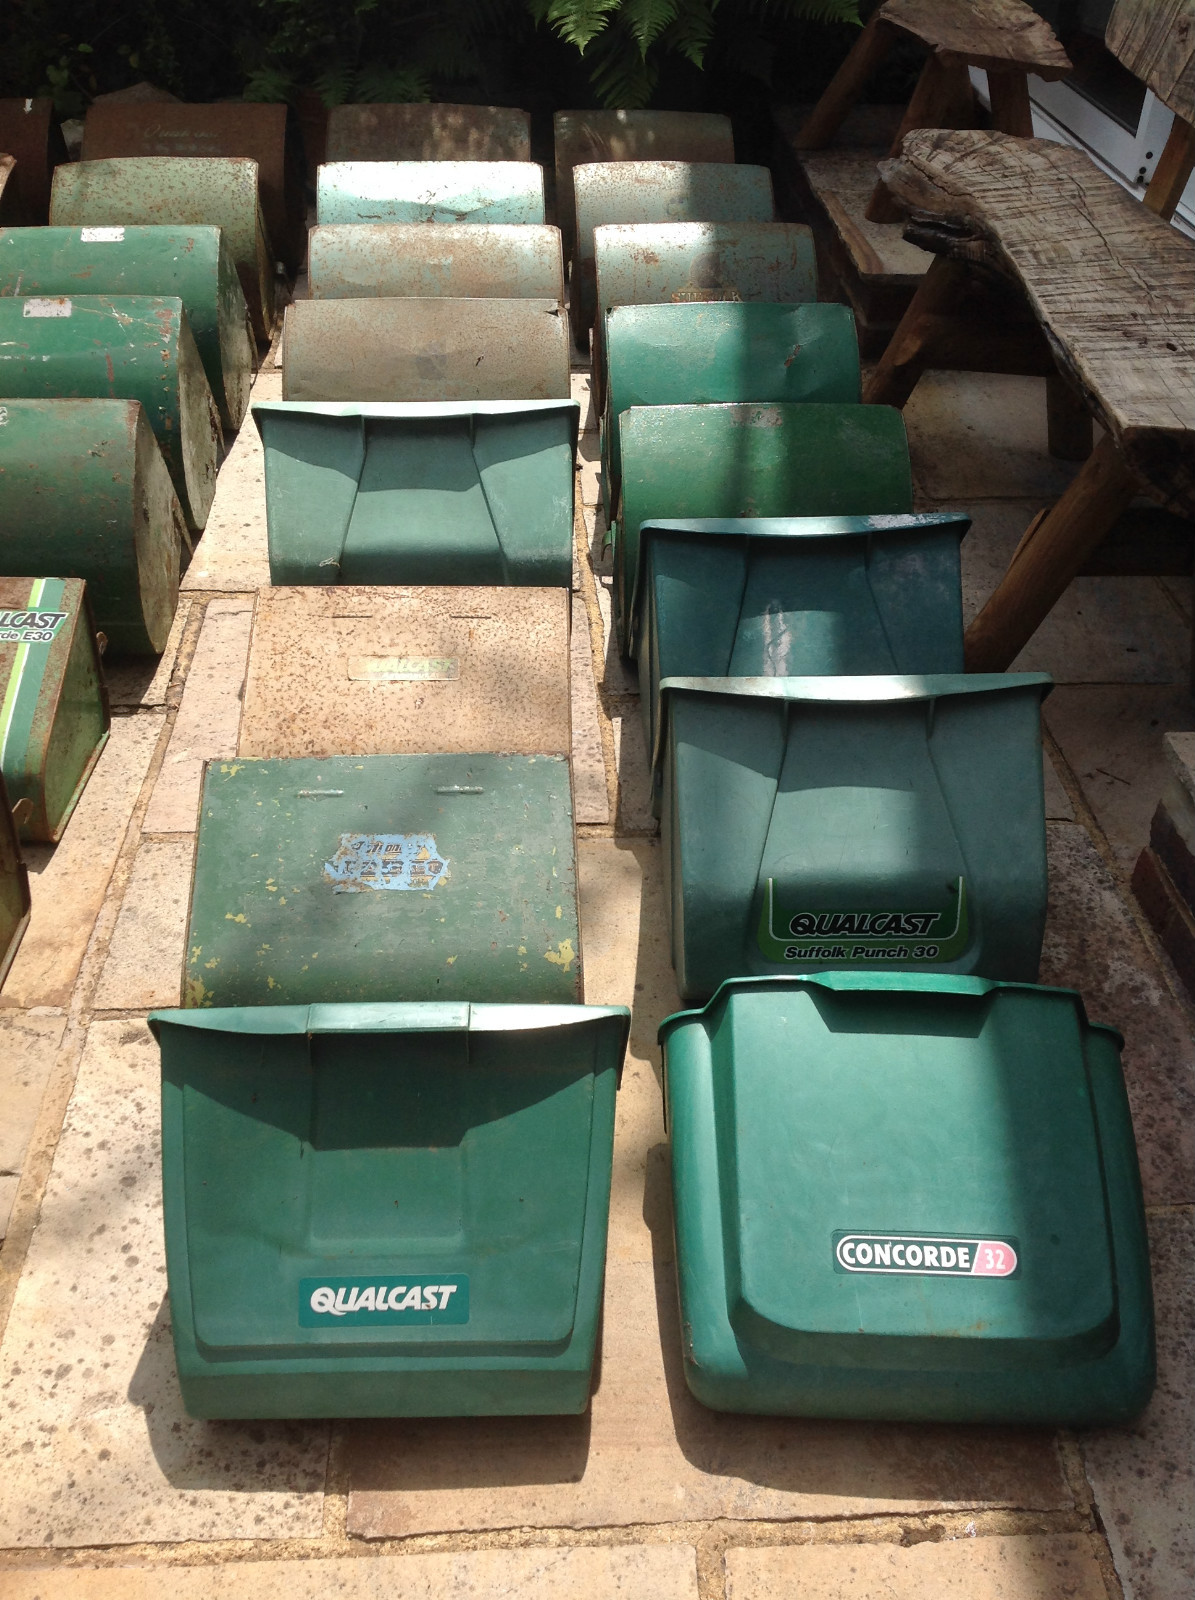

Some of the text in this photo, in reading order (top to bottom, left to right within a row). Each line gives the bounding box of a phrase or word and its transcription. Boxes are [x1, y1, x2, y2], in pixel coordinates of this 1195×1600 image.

[0, 611, 68, 629] LCAST
[21, 630, 54, 642] E30
[789, 912, 941, 936] QUALCAST
[785, 945, 939, 960] Suffolk Punch 30
[842, 1242, 1006, 1270] CONCORDE 32
[310, 1285, 458, 1317] QUALCAST
